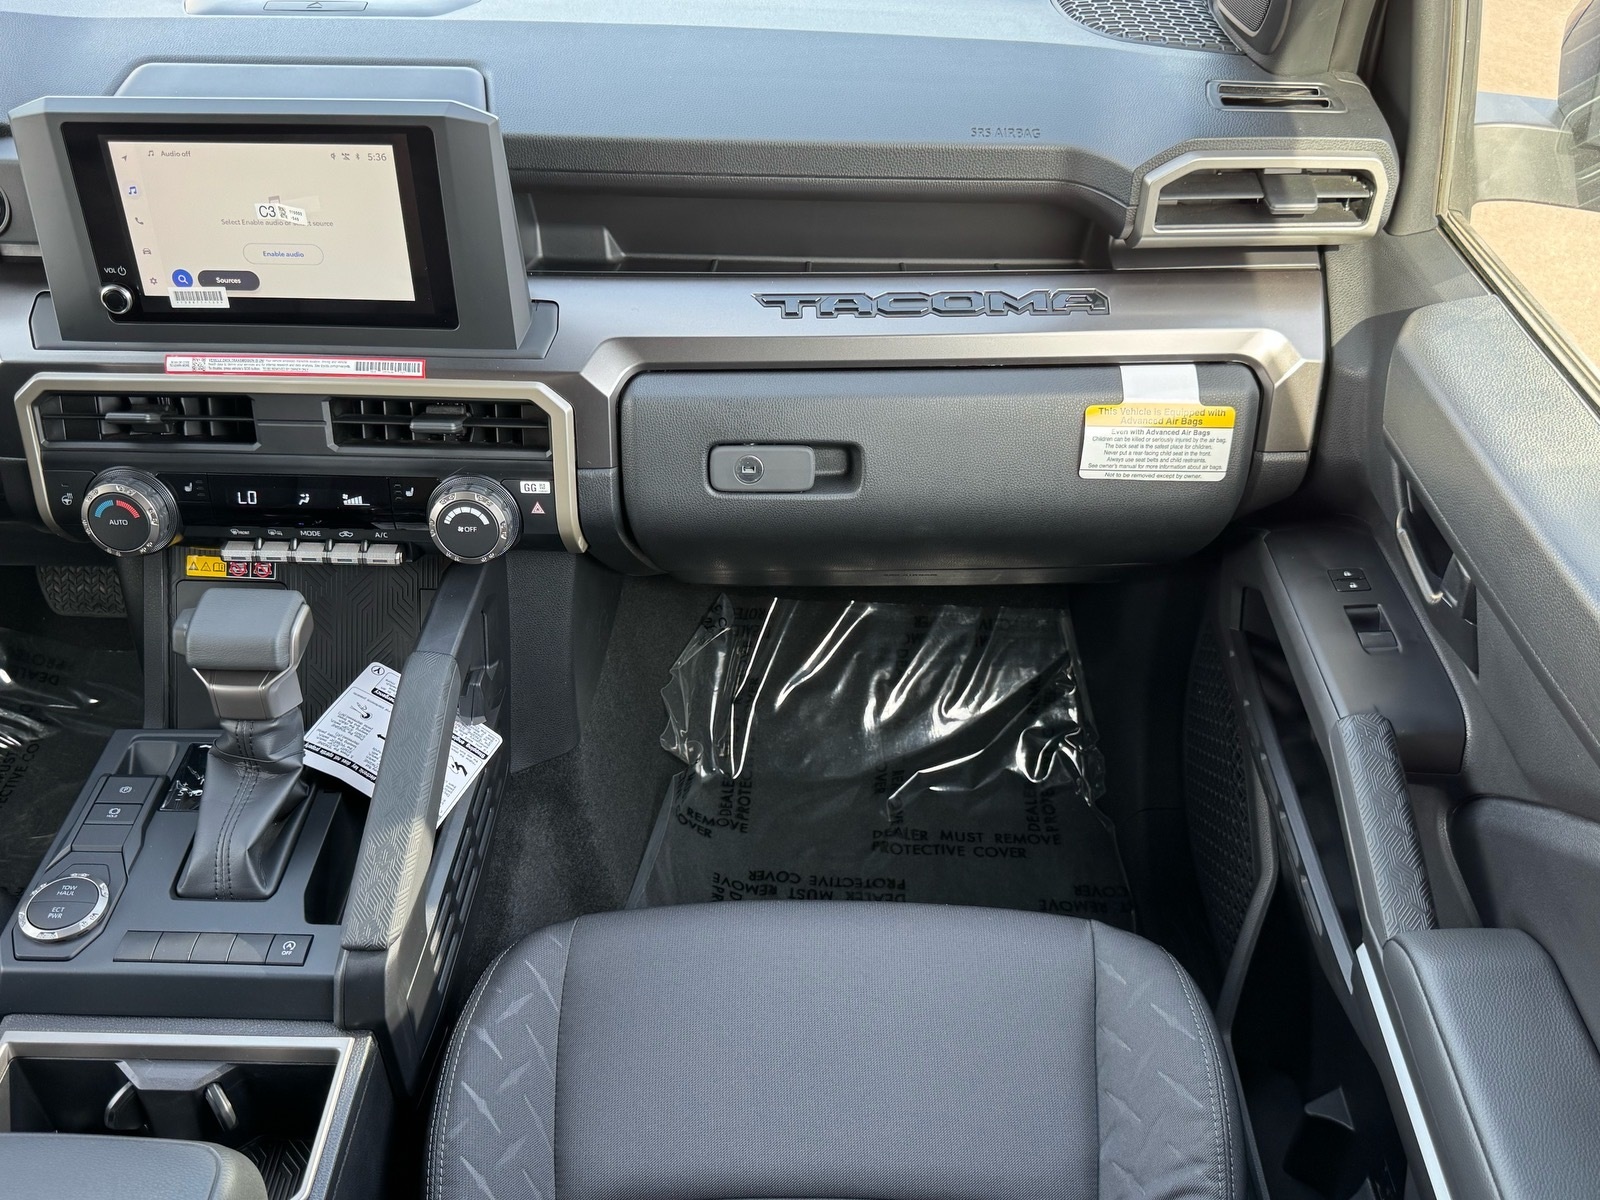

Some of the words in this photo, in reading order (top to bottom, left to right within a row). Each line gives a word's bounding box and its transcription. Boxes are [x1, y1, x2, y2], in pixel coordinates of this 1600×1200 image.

[971, 127, 991, 138] SRS
[994, 128, 1041, 138] AIRBAG
[368, 152, 387, 161] 5:36
[258, 205, 276, 218] C3
[750, 288, 1111, 320] TACOMA
[1098, 407, 1117, 415] This
[1120, 407, 1153, 416] Vehicle
[1164, 408, 1205, 418] Equipped
[1181, 418, 1203, 427] Bags
[524, 483, 537, 492] GG
[237, 490, 258, 505] LO
[686, 806, 749, 834] REMOVE
[873, 828, 928, 841] DEALER
[940, 830, 984, 843] MUST
[994, 833, 1062, 846] REMOVE
[871, 841, 965, 857] PROTECTIVE
[973, 847, 1026, 859] COVER
[713, 872, 777, 895] REMOVE
[788, 888, 833, 900] MUST
[748, 870, 801, 884] COVER
[809, 875, 906, 889] PROTECTIVE
